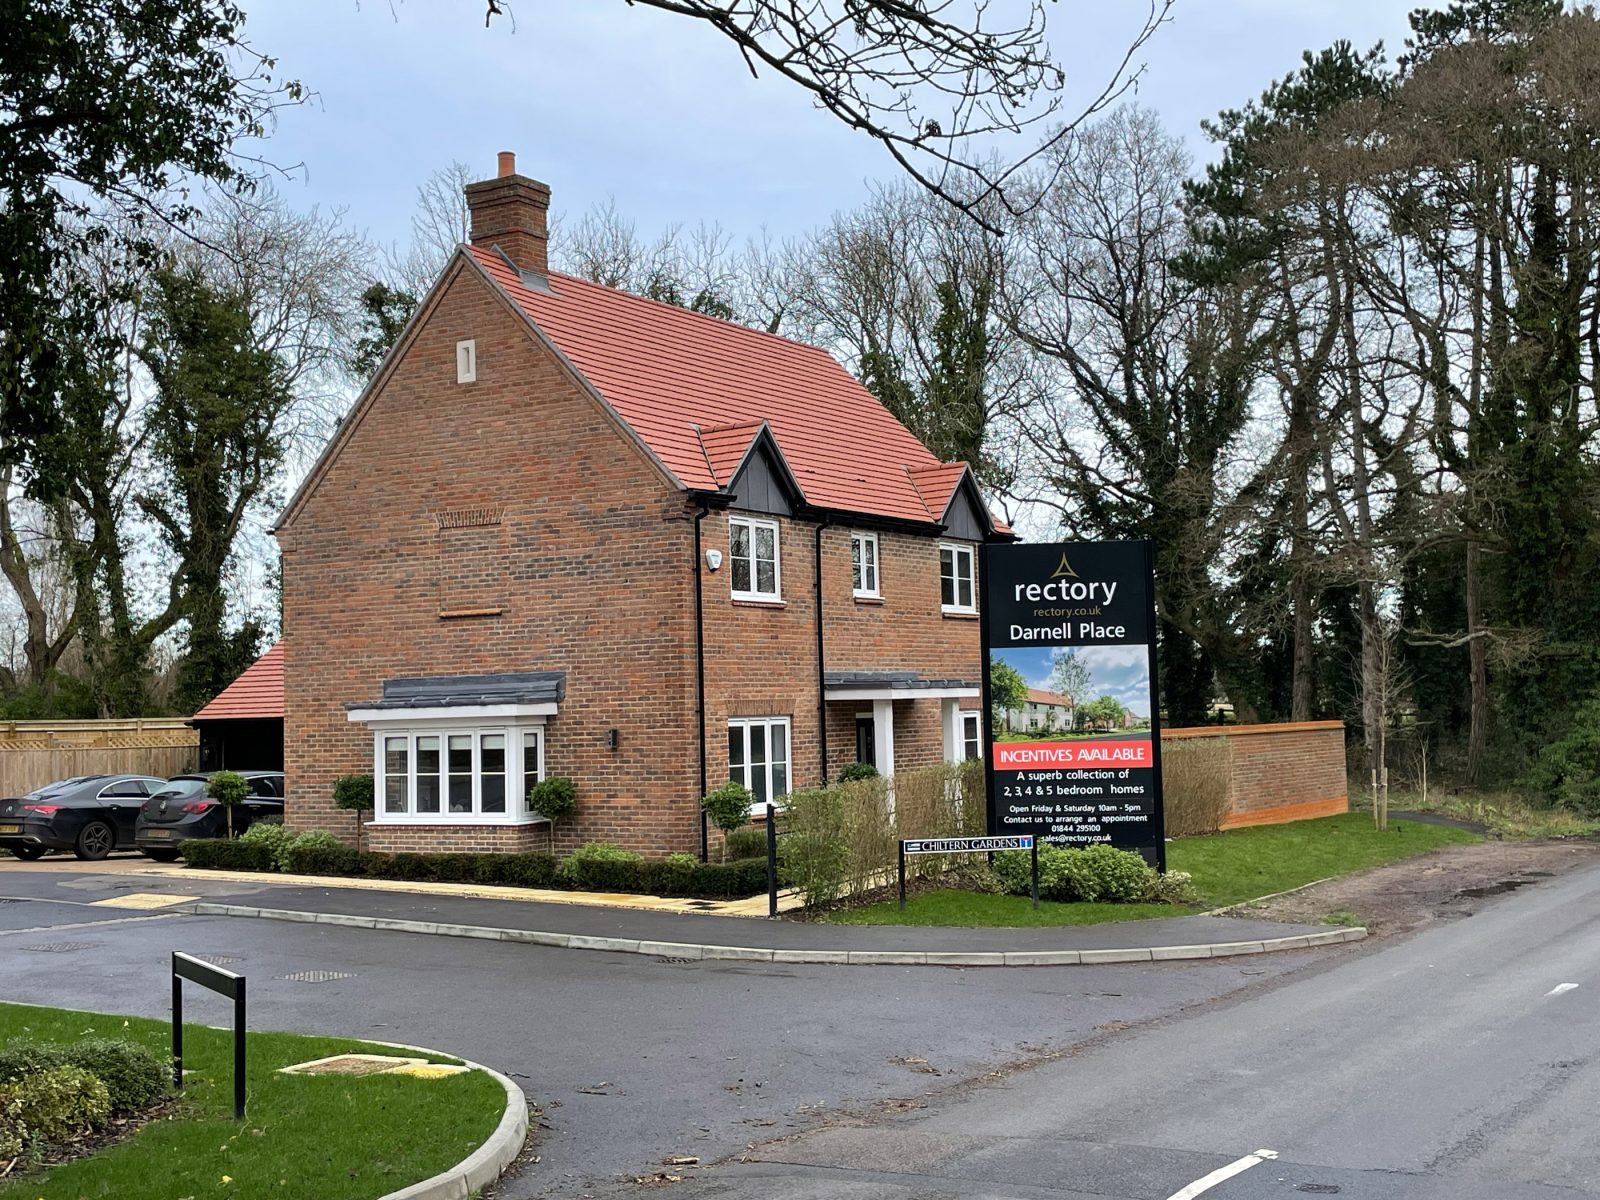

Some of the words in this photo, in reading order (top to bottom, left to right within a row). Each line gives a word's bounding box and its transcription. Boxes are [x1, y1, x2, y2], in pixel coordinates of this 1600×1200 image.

[1015, 579, 1117, 606] rectory
[1034, 606, 1101, 618] rectory.co.uk
[1010, 622, 1071, 640] Darnell
[1080, 622, 1125, 638] Place
[1001, 749, 1072, 763] INCENTIVES
[1078, 748, 1144, 761] AVAILABLE
[1017, 772, 1025, 780] A
[1028, 770, 1062, 782] superb
[1066, 769, 1114, 779] collection
[1119, 769, 1129, 779] of
[1025, 787, 1032, 795] 4
[1036, 786, 1044, 795] &
[1046, 786, 1052, 795] 5
[1057, 785, 1103, 795] bedroom
[1110, 784, 1144, 794] homes
[1009, 805, 1029, 814] Open
[1032, 805, 1053, 813] Friday
[1064, 804, 1095, 813] Saturday
[1099, 804, 1117, 812] 10am
[1125, 804, 1141, 813] 5pm
[1055, 816, 1083, 824] arrange
[1101, 815, 1148, 823] appointment
[922, 841, 968, 851] CHILTERN
[972, 838, 1018, 849] GARDENS
[1041, 834, 1112, 843] sales@rectory.co.uk
